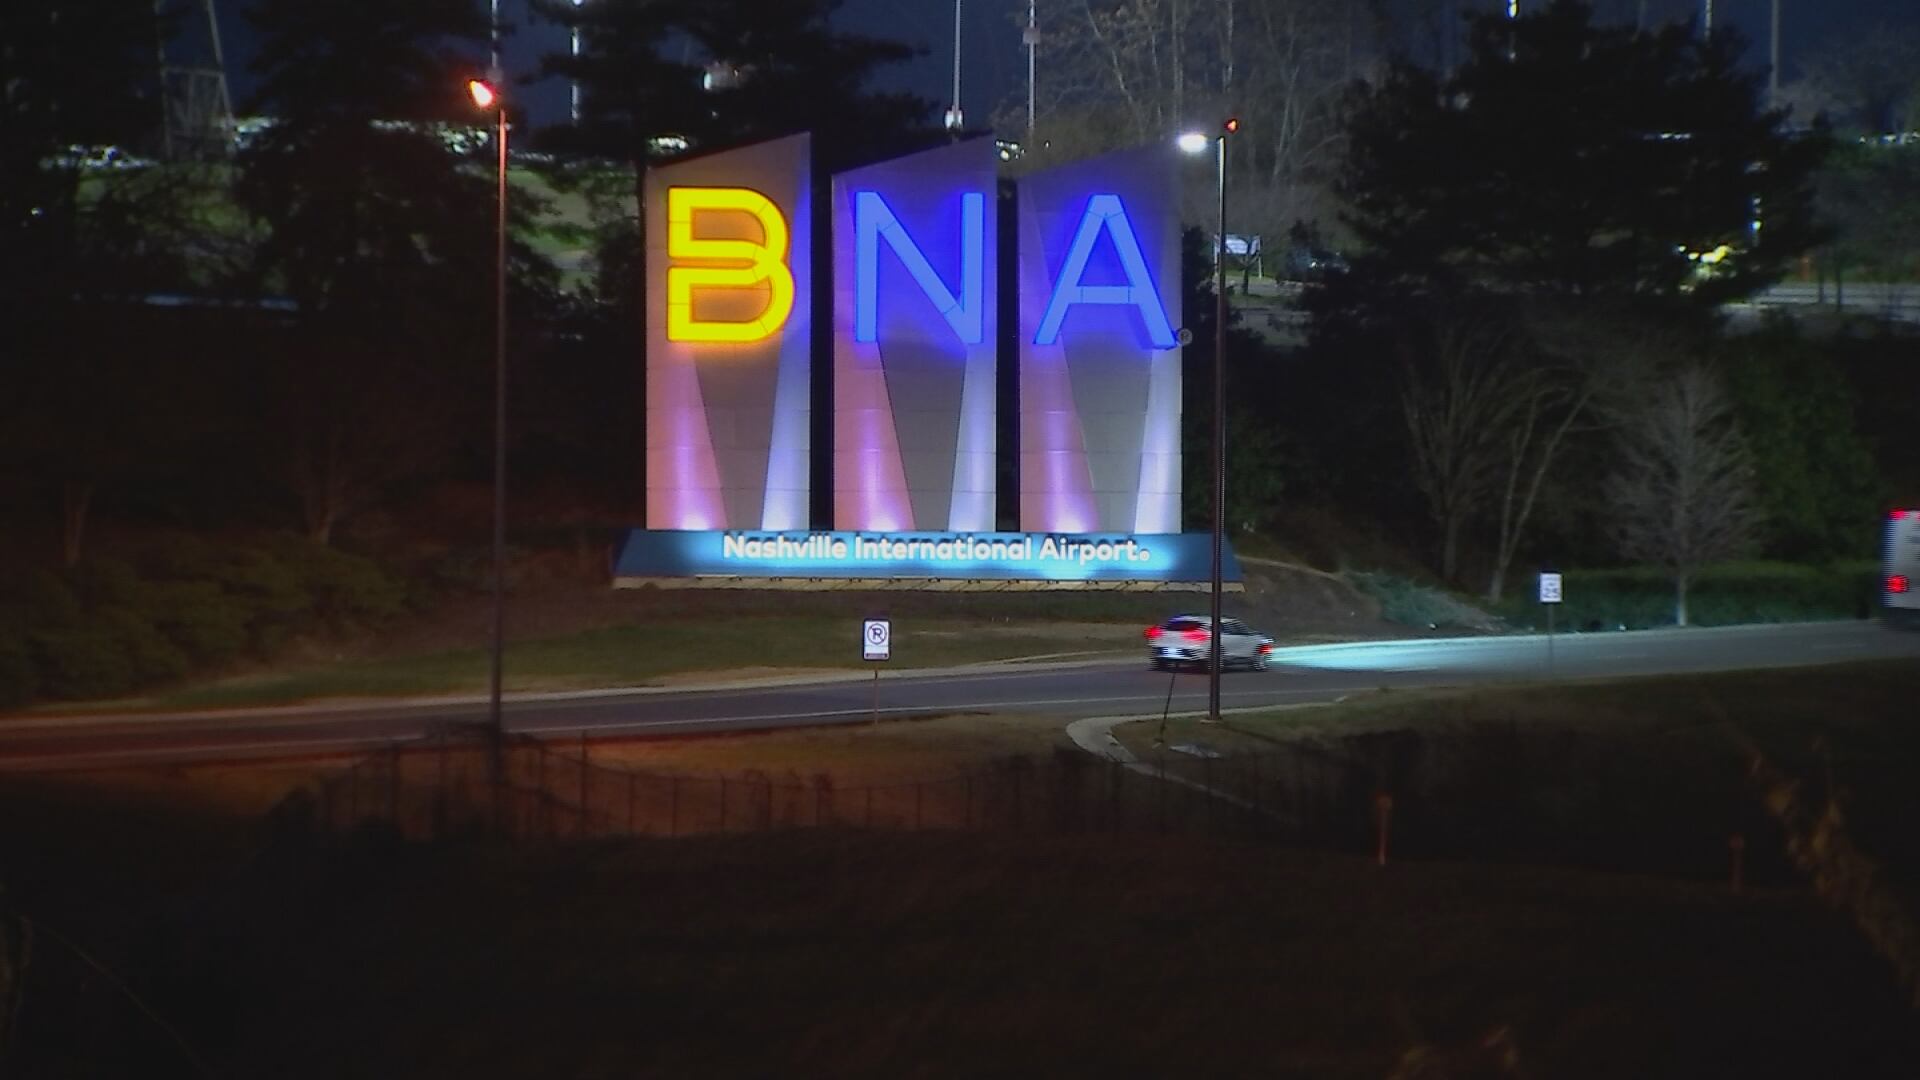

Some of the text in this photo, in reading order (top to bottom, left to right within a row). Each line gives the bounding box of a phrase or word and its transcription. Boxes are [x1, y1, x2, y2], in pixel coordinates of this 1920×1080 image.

[667, 186, 1177, 349] BNA
[723, 534, 847, 559] Nashville
[855, 535, 1031, 560] International
